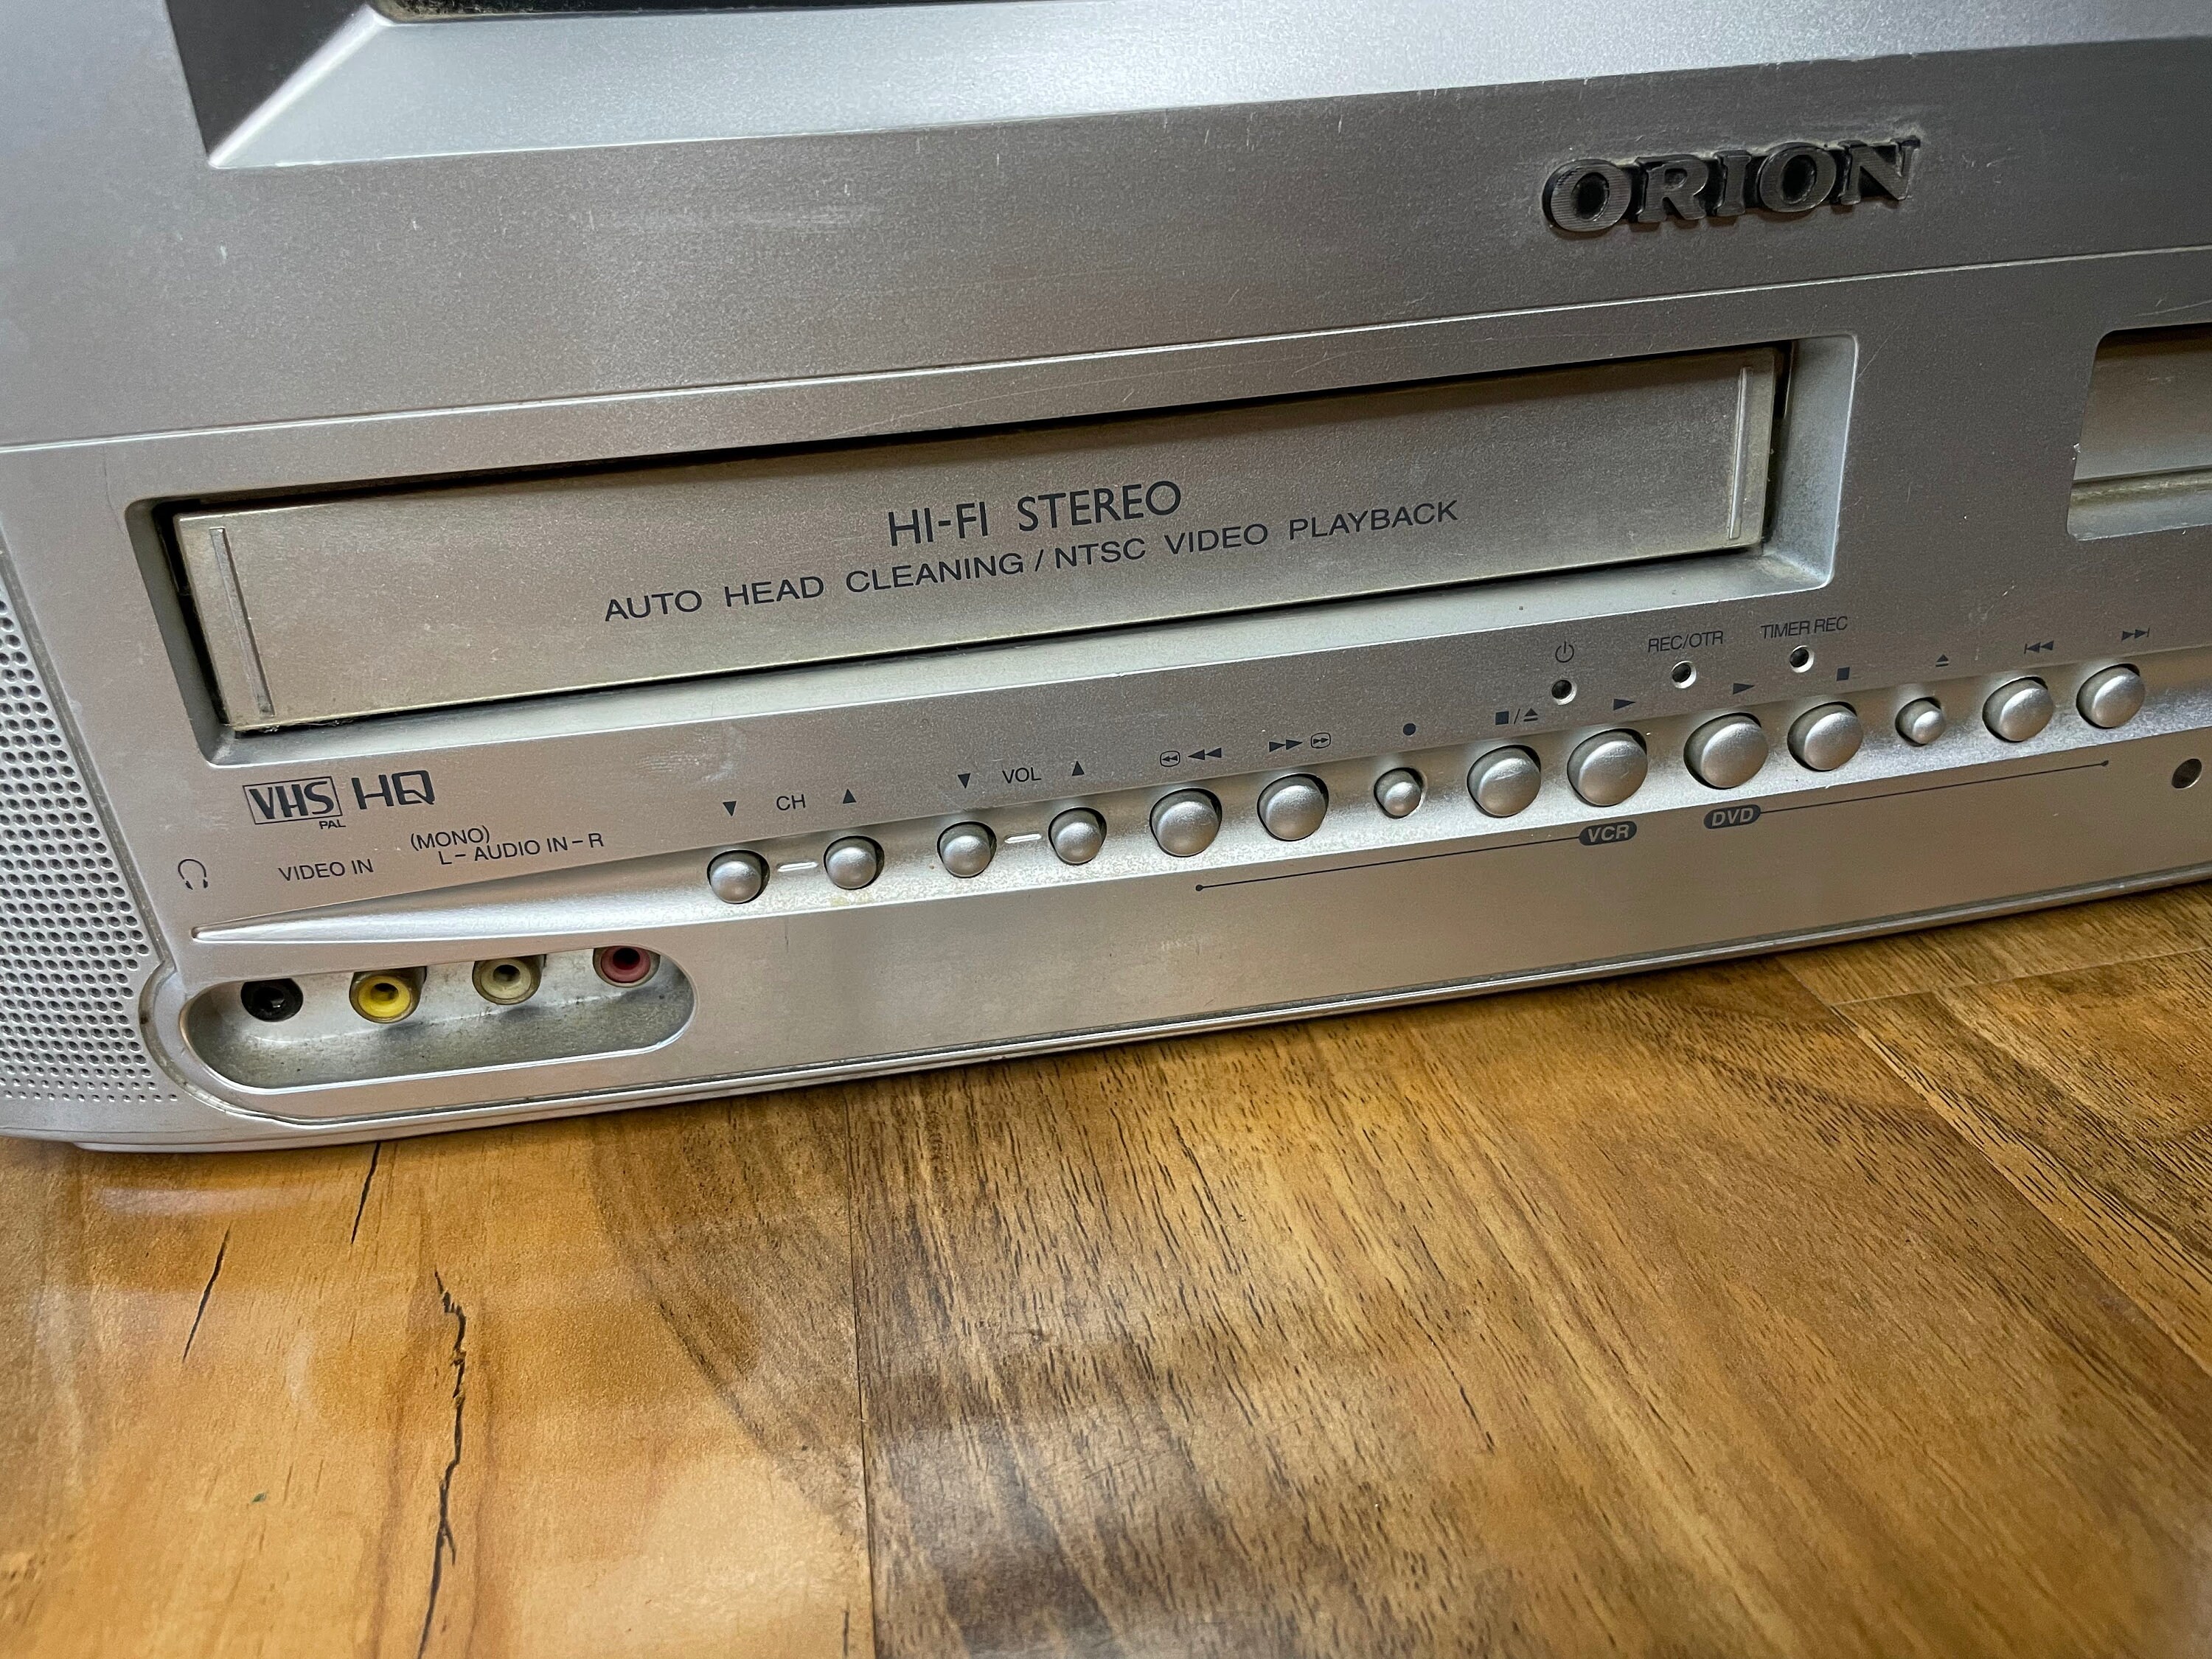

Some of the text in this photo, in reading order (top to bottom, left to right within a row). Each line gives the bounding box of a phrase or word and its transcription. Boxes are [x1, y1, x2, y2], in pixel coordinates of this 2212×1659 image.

[1543, 134, 1921, 232] ORION
[887, 480, 1181, 547] HI-FI STEREO
[605, 590, 703, 622] AUTO
[724, 576, 824, 607] HEAD
[1164, 524, 1268, 555] VIDEO
[1289, 499, 1458, 540] PLAYBACK
[1760, 615, 1848, 640] TIMER REC
[1647, 630, 1724, 653] REC/OTR
[1002, 767, 1042, 784] VOL
[248, 780, 335, 820] VHS
[351, 770, 436, 810] HQ
[776, 793, 806, 811] CH
[319, 818, 347, 830] PAL
[1711, 807, 1755, 827] DVD
[410, 824, 490, 852] (MONO)
[1587, 824, 1630, 843] VCR
[278, 858, 374, 881] VIDEO IN
